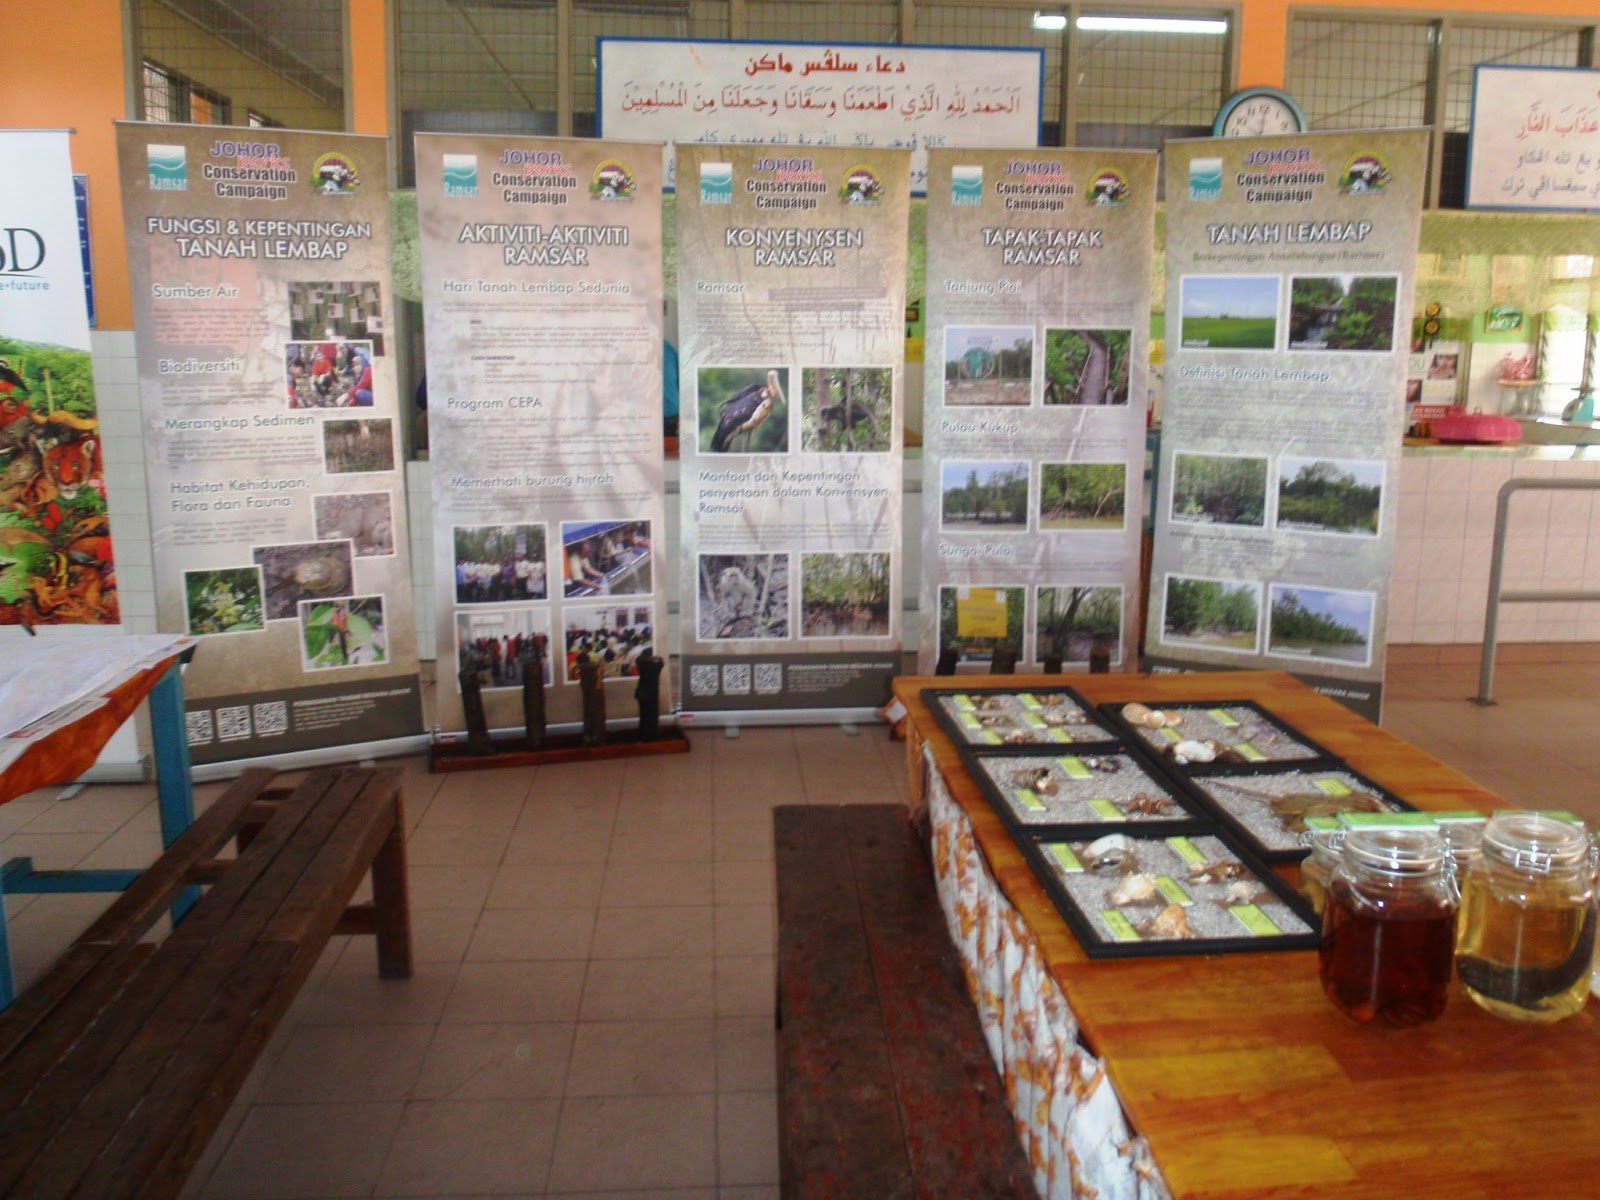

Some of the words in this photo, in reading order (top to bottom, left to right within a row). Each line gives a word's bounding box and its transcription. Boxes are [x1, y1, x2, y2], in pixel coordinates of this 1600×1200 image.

[210, 141, 280, 158] JOHOR
[500, 149, 562, 165] JOHOR
[1246, 147, 1311, 166] JOHOR
[236, 154, 291, 171] parks
[523, 163, 573, 177] parks
[753, 157, 814, 172] JOHOR
[1003, 160, 1062, 175] JOHOR
[203, 164, 296, 182] Conservation
[493, 172, 577, 188] Conservation
[1236, 171, 1325, 188] Conservation
[216, 183, 288, 200] Campaign
[746, 178, 827, 193] Conservation
[996, 181, 1074, 196] Conservation
[503, 189, 567, 204] Campaign
[756, 195, 817, 210] Campaign
[1246, 188, 1313, 204] Campaign
[1005, 197, 1065, 212] Campaign
[147, 217, 220, 235] FUNGSI
[227, 220, 240, 236] &
[245, 220, 372, 238] KEPENTINGAN
[459, 224, 629, 245] AKTIVITI-AKTIVITI
[1206, 222, 1281, 245] TANAH
[1286, 219, 1373, 244] LEMBAP
[725, 228, 863, 248] KONVENYSEN
[982, 228, 1103, 248] TAPAK-TAPAK
[176, 238, 257, 258] TANAH
[264, 240, 348, 260] LEMBAP
[504, 246, 588, 266] RAMSAR
[1003, 247, 1082, 267] RAMSAR
[754, 248, 835, 267] RAMSAR
[152, 284, 212, 299] Sumber
[216, 286, 238, 298] Air
[443, 280, 472, 293] Hari
[476, 280, 517, 293] Tanah
[521, 281, 574, 295] Lembap
[578, 282, 630, 294] Sedunia
[696, 281, 745, 294] Ramsar
[159, 359, 240, 374] Biodiversiti
[447, 397, 503, 412] Program
[508, 397, 543, 408] CEPA
[165, 415, 249, 432] Merangkap
[253, 414, 315, 428] Sedimen
[451, 475, 522, 488] Memerhati
[526, 474, 572, 488] burung
[698, 470, 751, 482] Manfaat
[754, 470, 778, 482] dan
[782, 470, 861, 484] Kepentingan
[170, 481, 224, 495] Habitat
[172, 499, 209, 513] Flora
[214, 498, 241, 511] dan
[246, 496, 291, 510] Fauna
